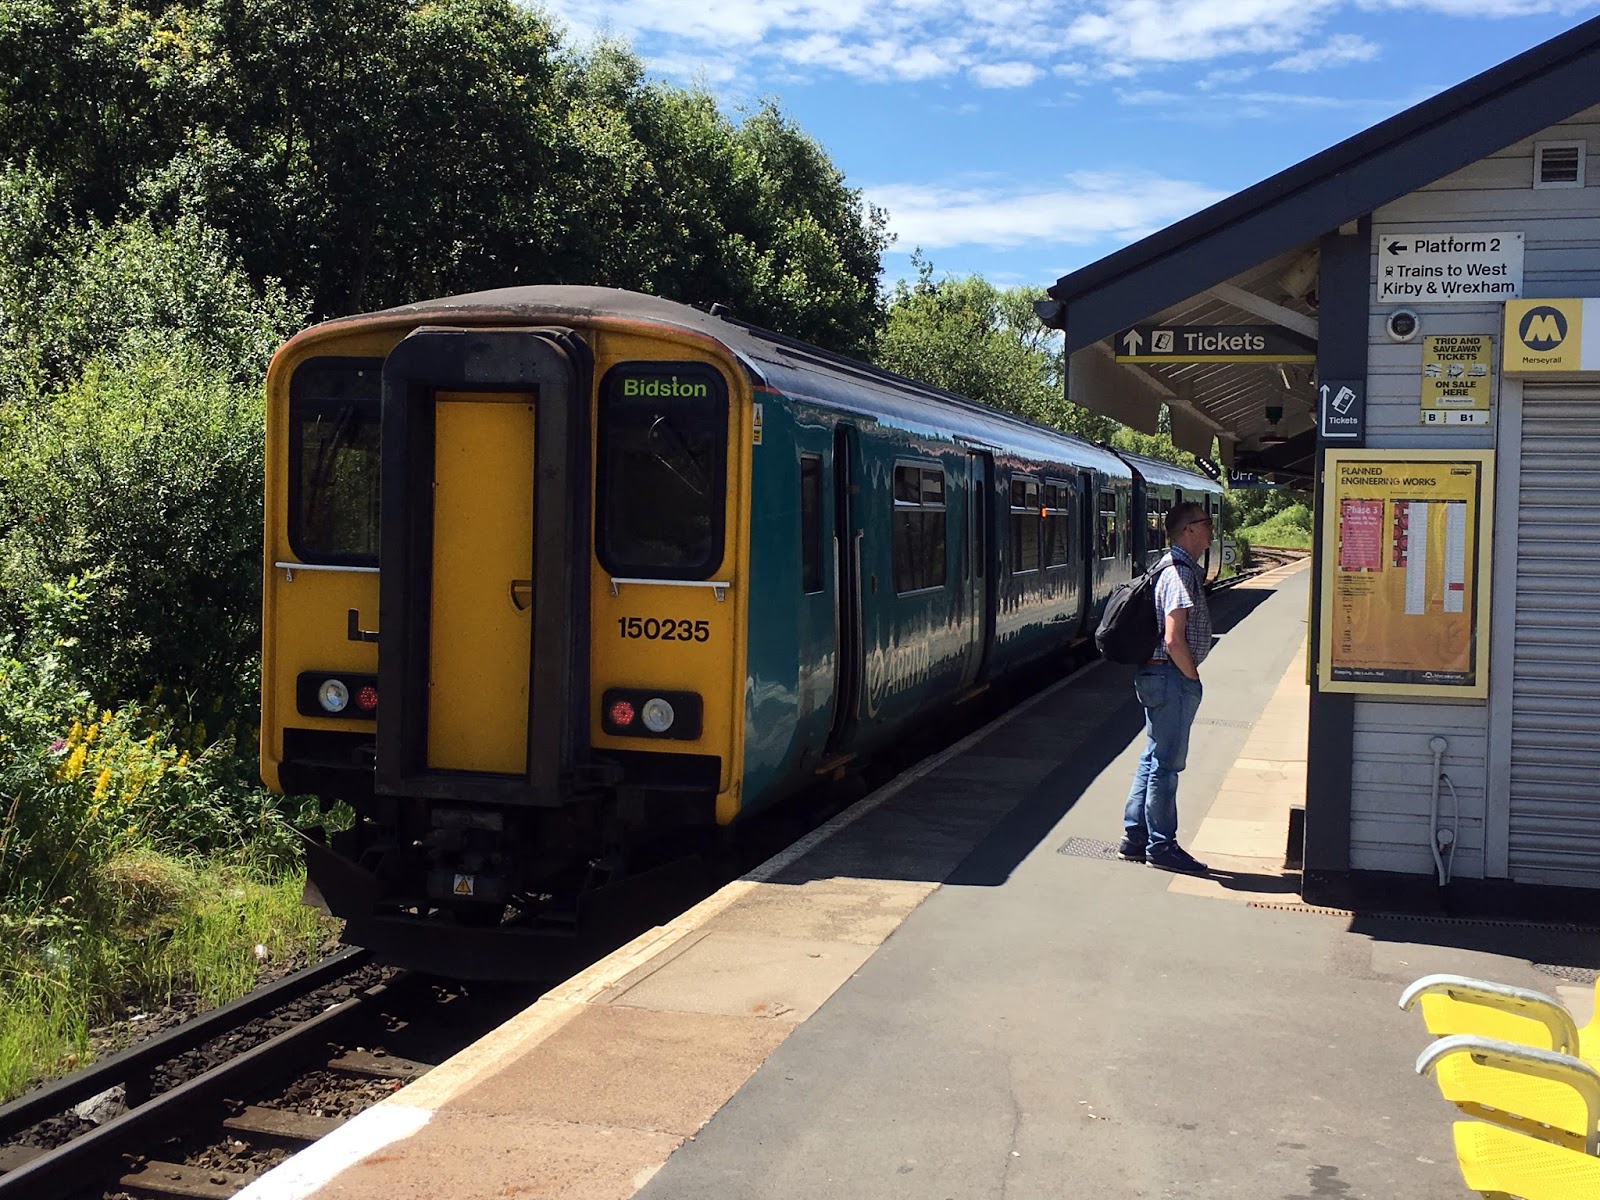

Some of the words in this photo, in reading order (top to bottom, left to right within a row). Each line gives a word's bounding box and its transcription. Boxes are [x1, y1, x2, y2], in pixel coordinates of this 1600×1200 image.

[1414, 239, 1486, 253] Platform
[1490, 238, 1501, 252] 2
[1397, 265, 1443, 278] Trains
[1447, 264, 1462, 276] to
[1467, 263, 1507, 276] West
[1383, 282, 1422, 296] Kirby
[1426, 281, 1437, 294] &
[1441, 281, 1515, 294] Wrexham
[1183, 332, 1266, 351] Tickets
[1435, 337, 1457, 345] TRIO
[1460, 337, 1480, 345] AND
[1433, 345, 1482, 353] SAVEAWAY
[1436, 353, 1478, 361] TICKETS
[1522, 356, 1562, 365] Merseyrail
[624, 378, 707, 397] Bidston
[1435, 381, 1449, 389] ON
[1442, 388, 1469, 396] HERE
[1329, 416, 1359, 425] Tickets
[1428, 413, 1436, 422] B
[1460, 414, 1473, 422] B1
[1341, 467, 1383, 476] PLANNED
[1341, 477, 1400, 486] ENGINEERING
[1402, 477, 1437, 486] WORKS
[1346, 505, 1371, 514] Phase
[1373, 506, 1379, 515] 3
[1224, 551, 1232, 561] 5
[617, 616, 710, 642] 150235
